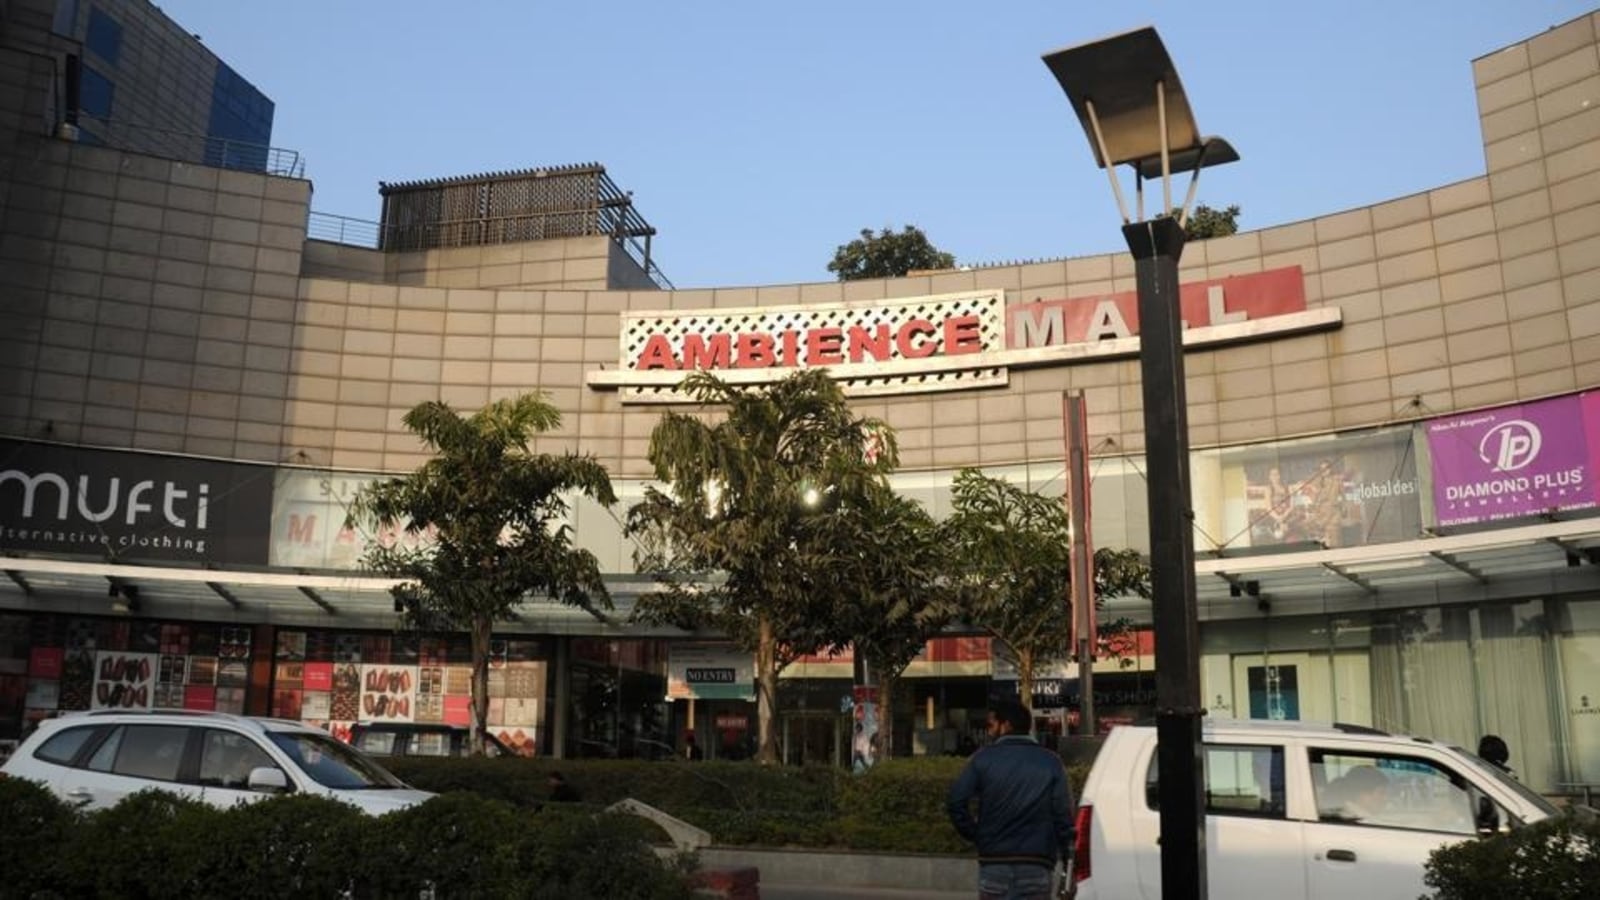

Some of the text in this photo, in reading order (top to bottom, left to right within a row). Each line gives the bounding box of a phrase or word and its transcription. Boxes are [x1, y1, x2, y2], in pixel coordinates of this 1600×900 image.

[635, 285, 1248, 371] AMBIENCE MAL
[1446, 469, 1583, 500] DIAMOND PLUS
[0, 525, 206, 553] lternative clothing
[687, 669, 733, 682] NO ENTRY
